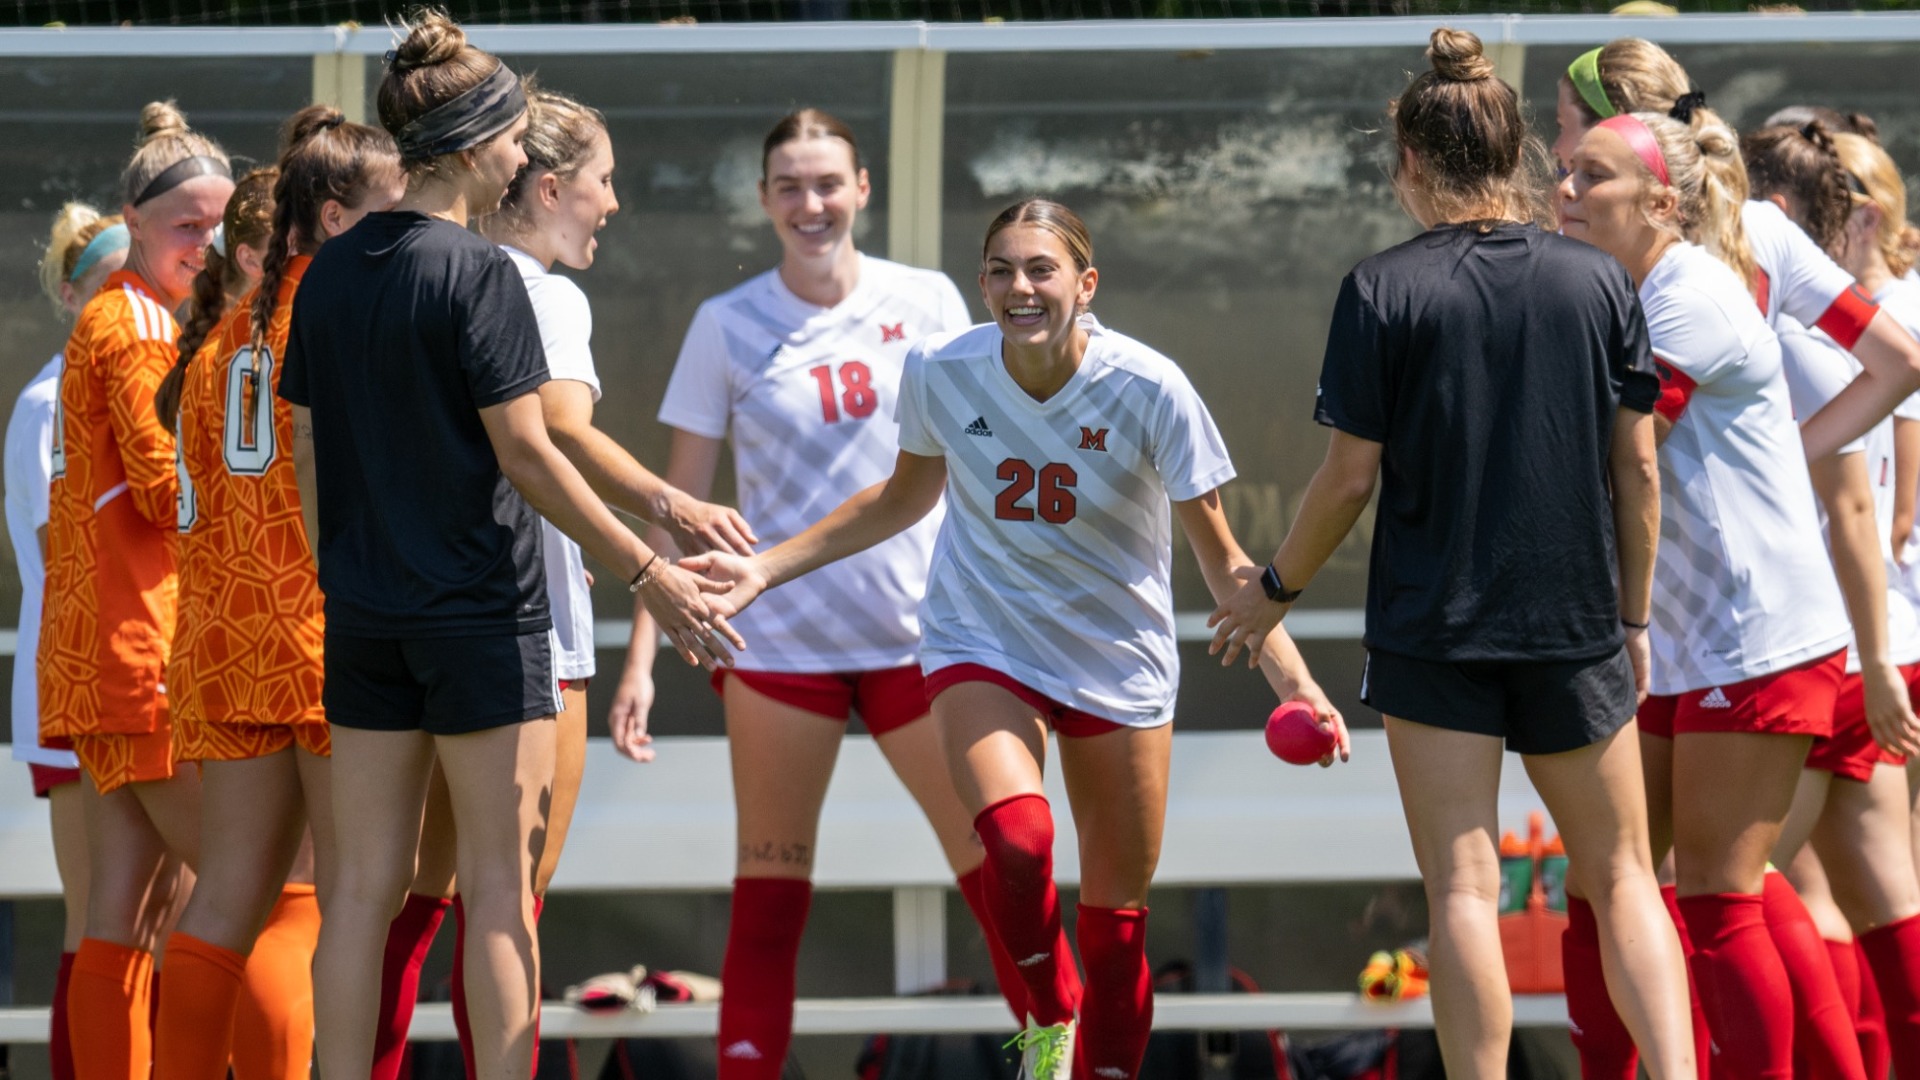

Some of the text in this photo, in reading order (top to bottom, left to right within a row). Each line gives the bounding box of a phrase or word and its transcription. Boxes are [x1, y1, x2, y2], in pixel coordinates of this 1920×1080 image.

[879, 321, 905, 344] M
[223, 344, 277, 476] 0
[809, 360, 879, 425] 18
[964, 427, 993, 438] adidas
[1077, 426, 1110, 453] M
[995, 457, 1078, 525] 26
